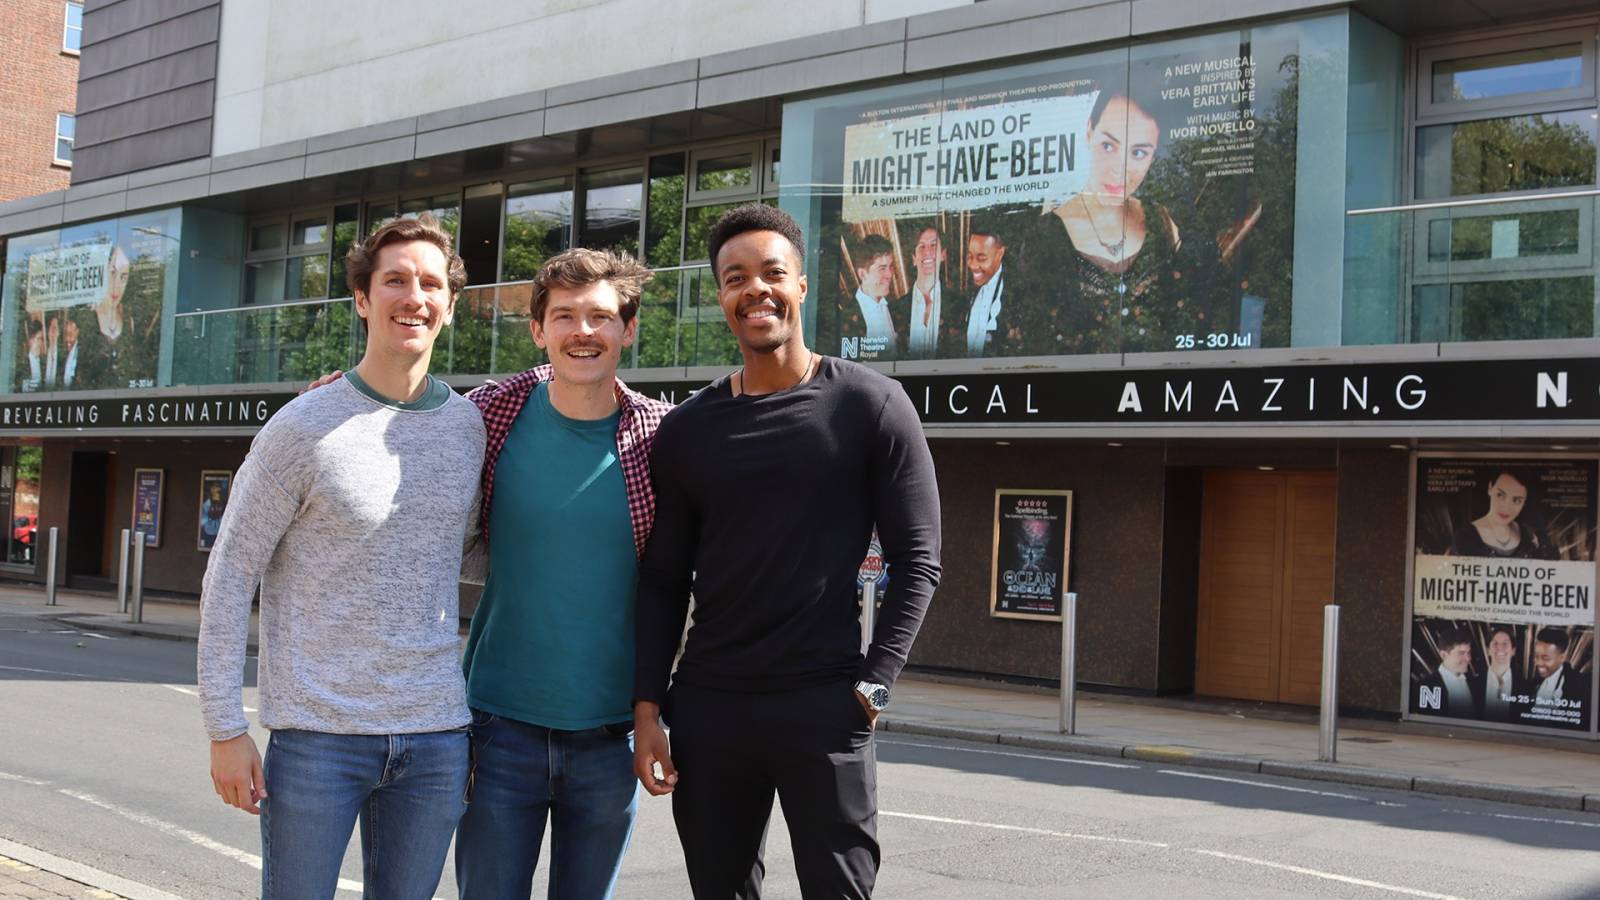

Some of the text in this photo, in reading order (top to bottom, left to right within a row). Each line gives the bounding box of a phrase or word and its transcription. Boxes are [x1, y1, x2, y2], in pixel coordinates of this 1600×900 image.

[1164, 56, 1256, 77] A NEW MUSICAL
[1200, 67, 1256, 83] INSPIRED BY
[891, 103, 935, 113] INTERNATIONAL
[965, 95, 977, 103] AND
[979, 91, 1007, 100] NORWICH
[1009, 87, 1037, 96] THEATRE
[1038, 79, 1091, 92] CO-PRODUCTION
[1161, 79, 1256, 100] VERA BRITTAIN'S
[1193, 91, 1255, 108] EARLY LIFE
[1187, 108, 1256, 125] WITH MUSIC BY
[892, 113, 1032, 149] THE LAND OF
[1170, 120, 1255, 139] IVOR NOVELLO
[852, 132, 1076, 195] MIGHT-HAVE-BEEN
[872, 181, 1050, 207] A SUMMER THAT CHANGED THE WORLD
[841, 336, 858, 359] N
[860, 336, 889, 344] Norwich
[860, 343, 886, 351] Theatre
[1175, 334, 1195, 349] 25
[1207, 333, 1229, 348] 30
[1231, 332, 1252, 347] Jul
[860, 351, 878, 359] Royal
[925, 383, 1039, 414] ICAL
[1536, 371, 1568, 408] N
[3, 400, 268, 424] REVEALING FASCINATING
[1003, 569, 1057, 588] OCEAN
[1452, 563, 1557, 580] THE LAND OF
[1421, 577, 1589, 610] MIGHT-HAVE-BEEN
[1492, 607, 1527, 616] CHANGED
[1544, 610, 1570, 618] WORLD
[1419, 685, 1441, 709] N
[1501, 693, 1517, 702] Tue
[1518, 694, 1530, 704] 25
[1569, 700, 1581, 709] Jul
